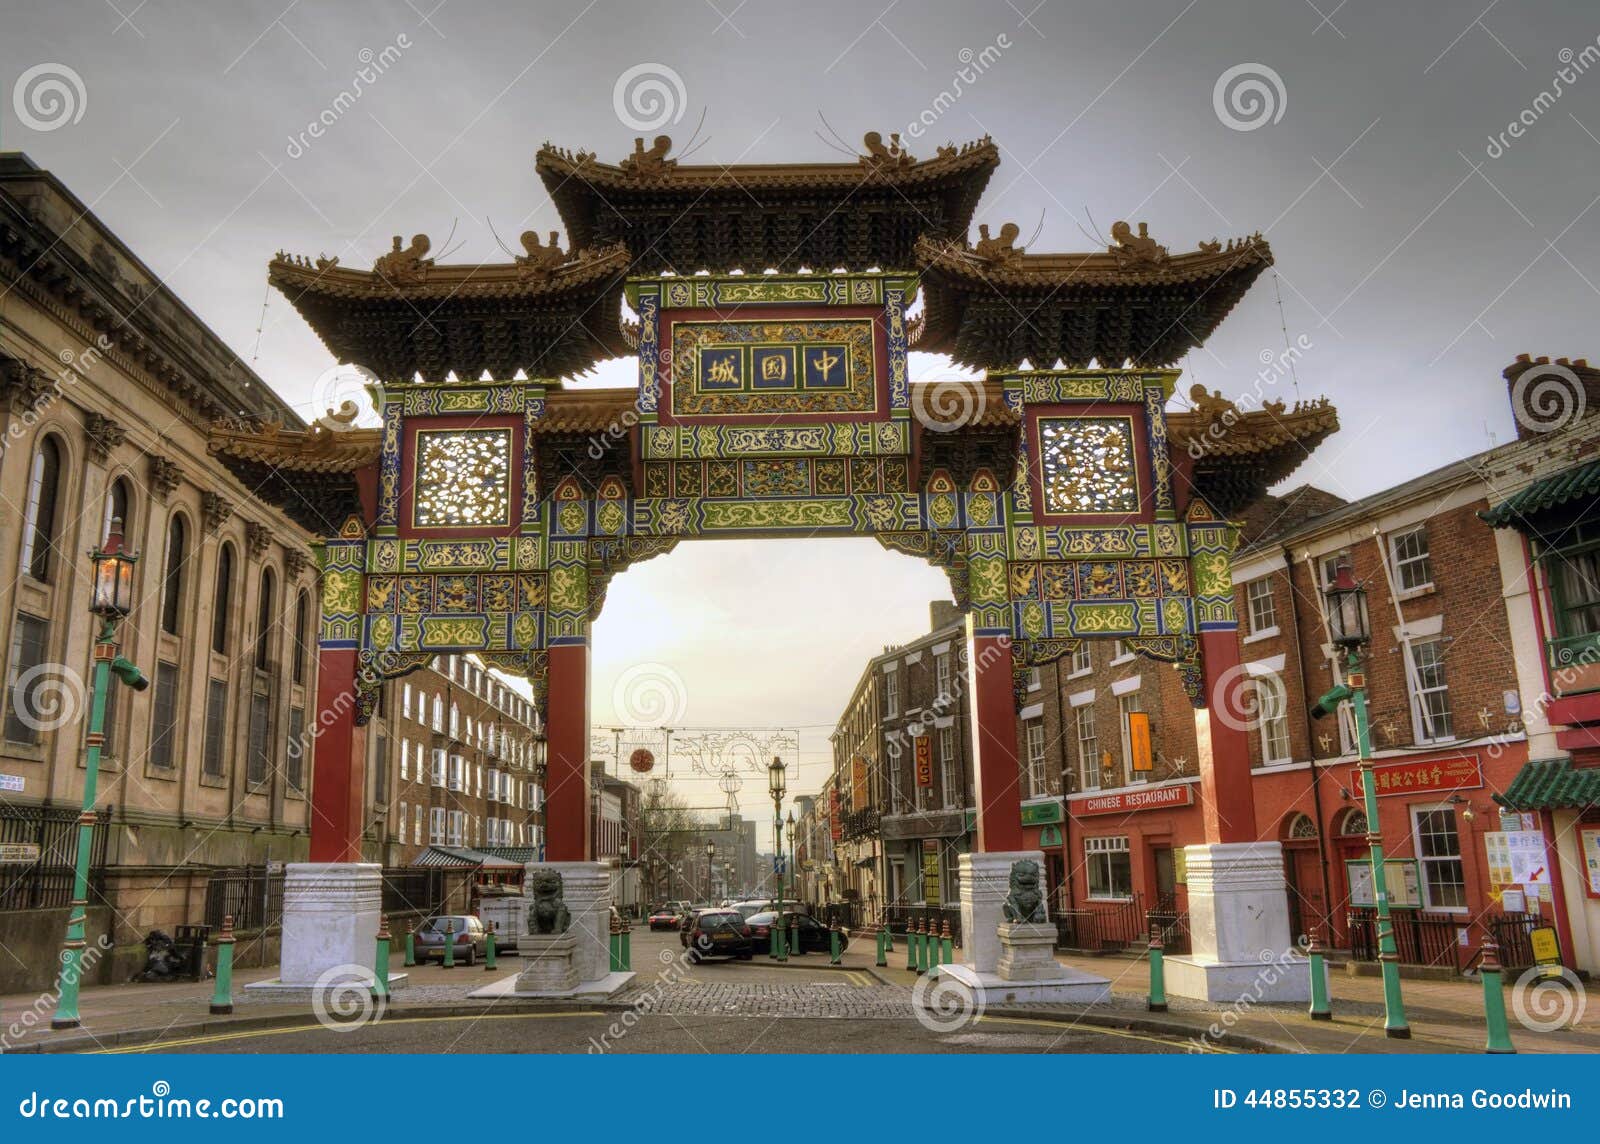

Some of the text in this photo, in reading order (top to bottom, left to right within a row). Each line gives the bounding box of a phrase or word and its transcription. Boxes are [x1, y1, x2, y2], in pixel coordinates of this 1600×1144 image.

[916, 737, 930, 784] WONGS
[1087, 788, 1181, 811] CHINESE RESTAURANT
